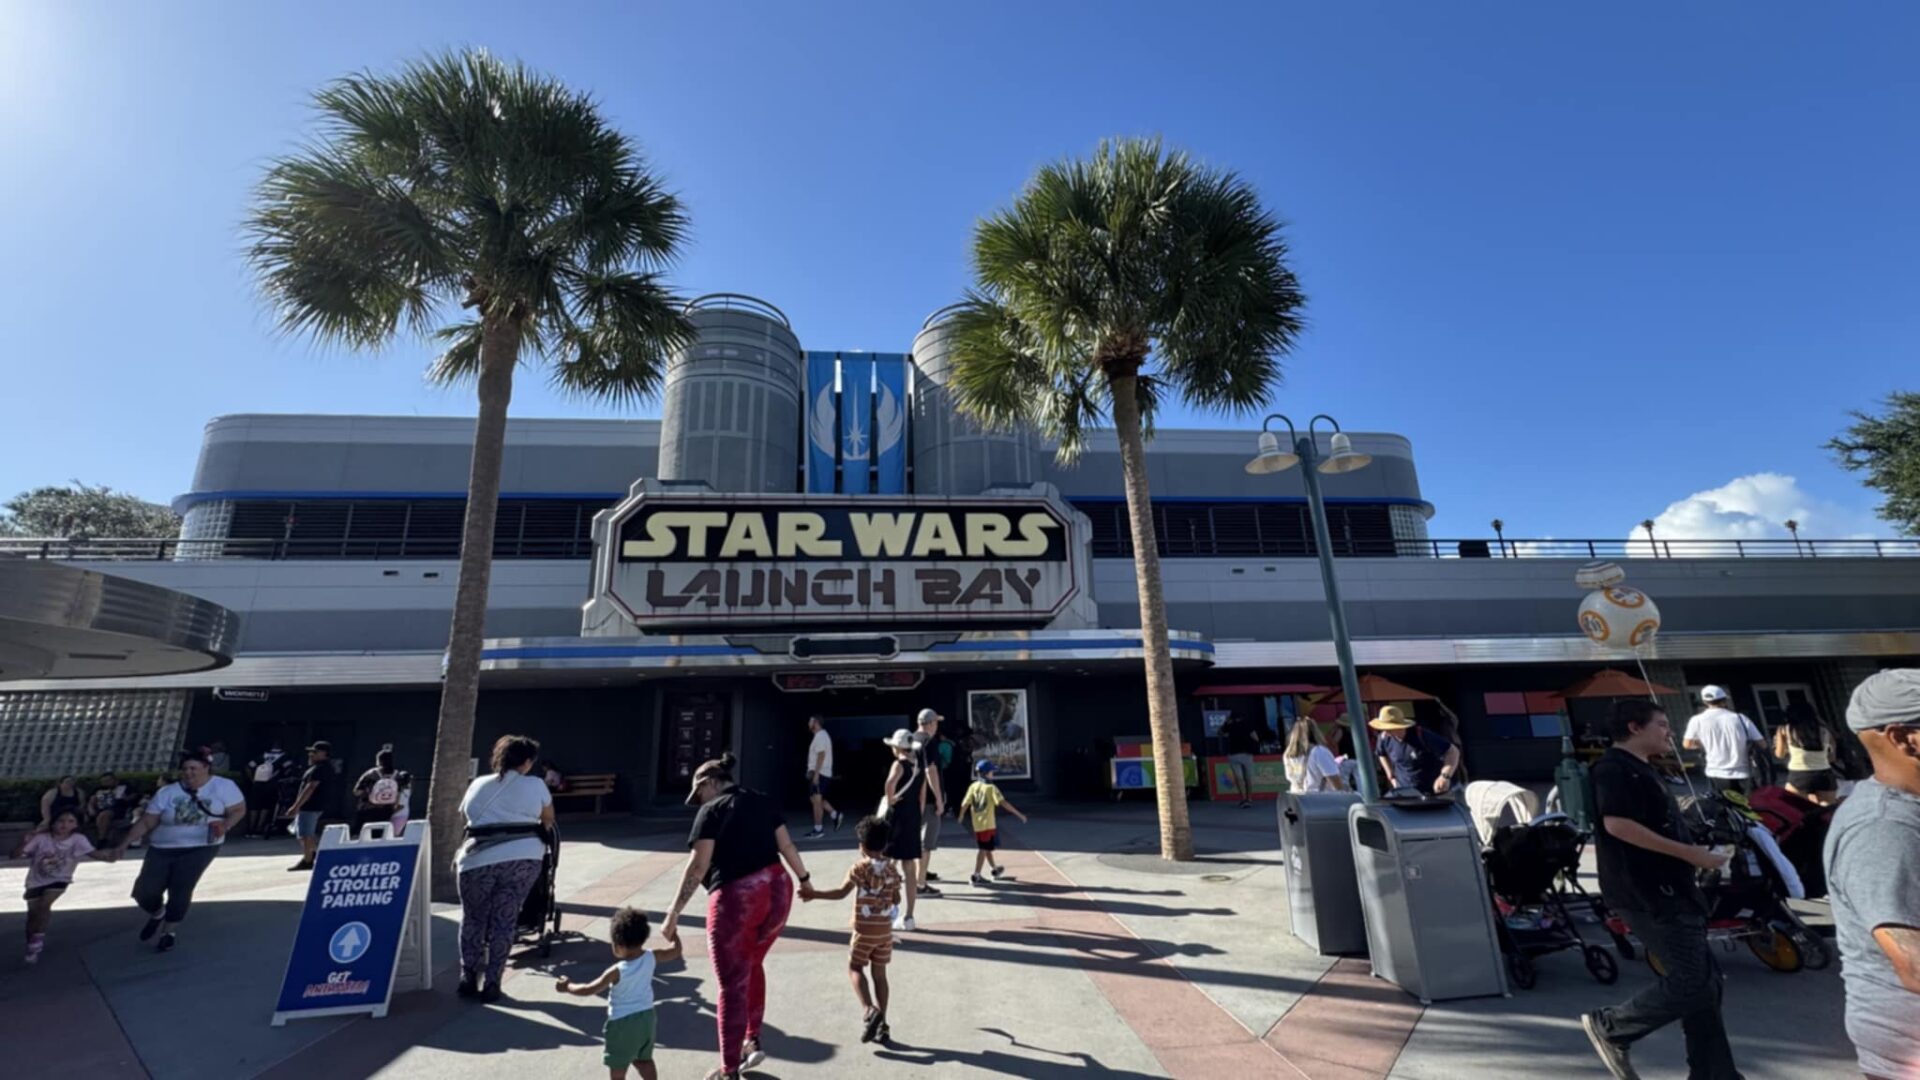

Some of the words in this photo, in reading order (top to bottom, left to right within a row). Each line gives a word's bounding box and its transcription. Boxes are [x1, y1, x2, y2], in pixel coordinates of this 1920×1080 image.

[622, 511, 843, 557] STAR
[848, 511, 1062, 557] WARS
[645, 568, 896, 608] LAUNCH
[914, 567, 1042, 606] BAY
[329, 861, 401, 878] COVERED
[322, 876, 400, 894] STROLLER
[322, 891, 393, 908] PARKING
[327, 971, 352, 984] GET
